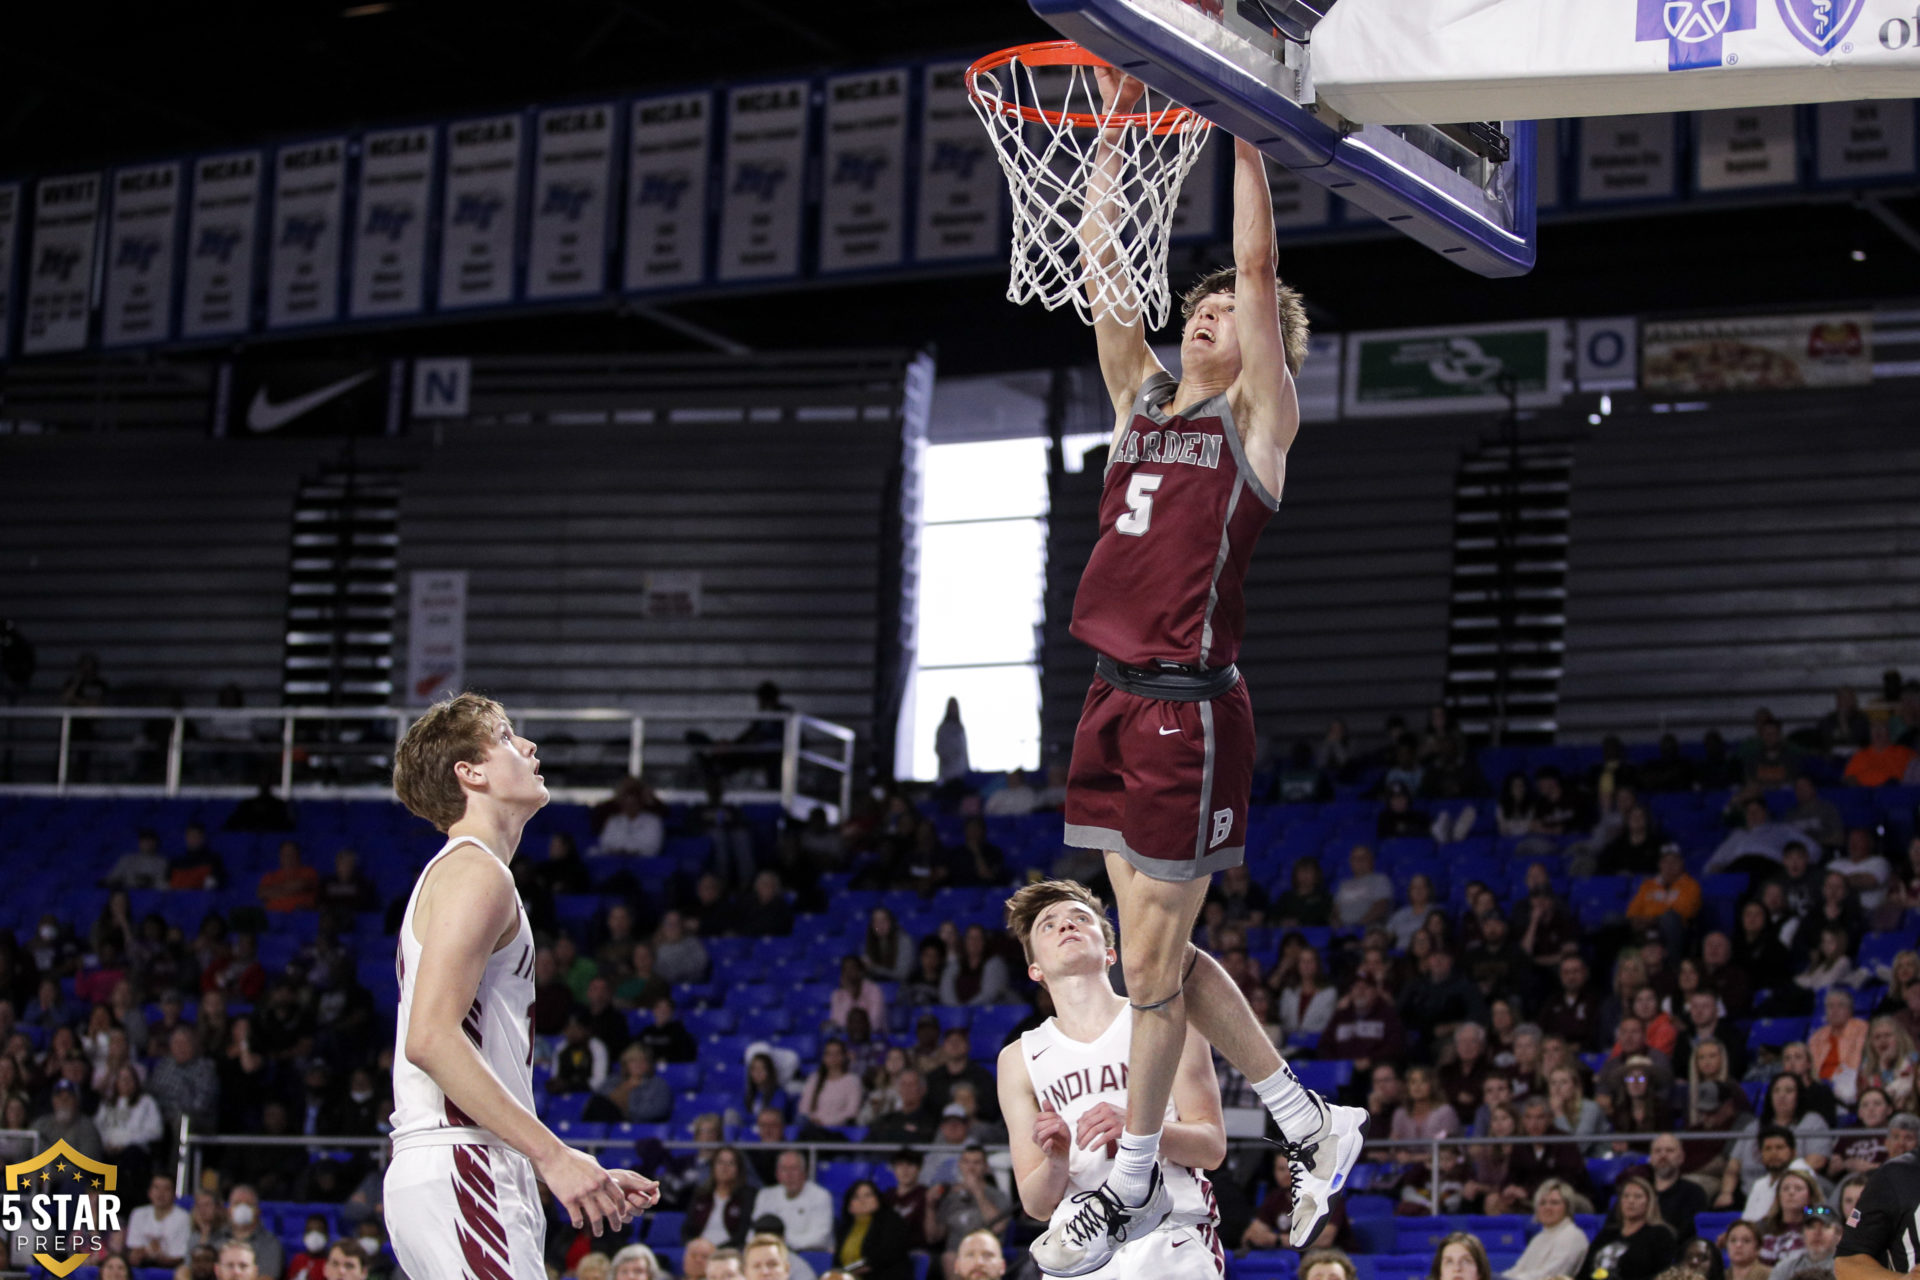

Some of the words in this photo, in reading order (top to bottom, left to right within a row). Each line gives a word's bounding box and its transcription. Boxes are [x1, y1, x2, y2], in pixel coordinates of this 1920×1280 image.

[1588, 329, 1624, 369] O
[426, 369, 458, 405] N
[1115, 473, 1163, 537] 5
[1209, 807, 1233, 848] B
